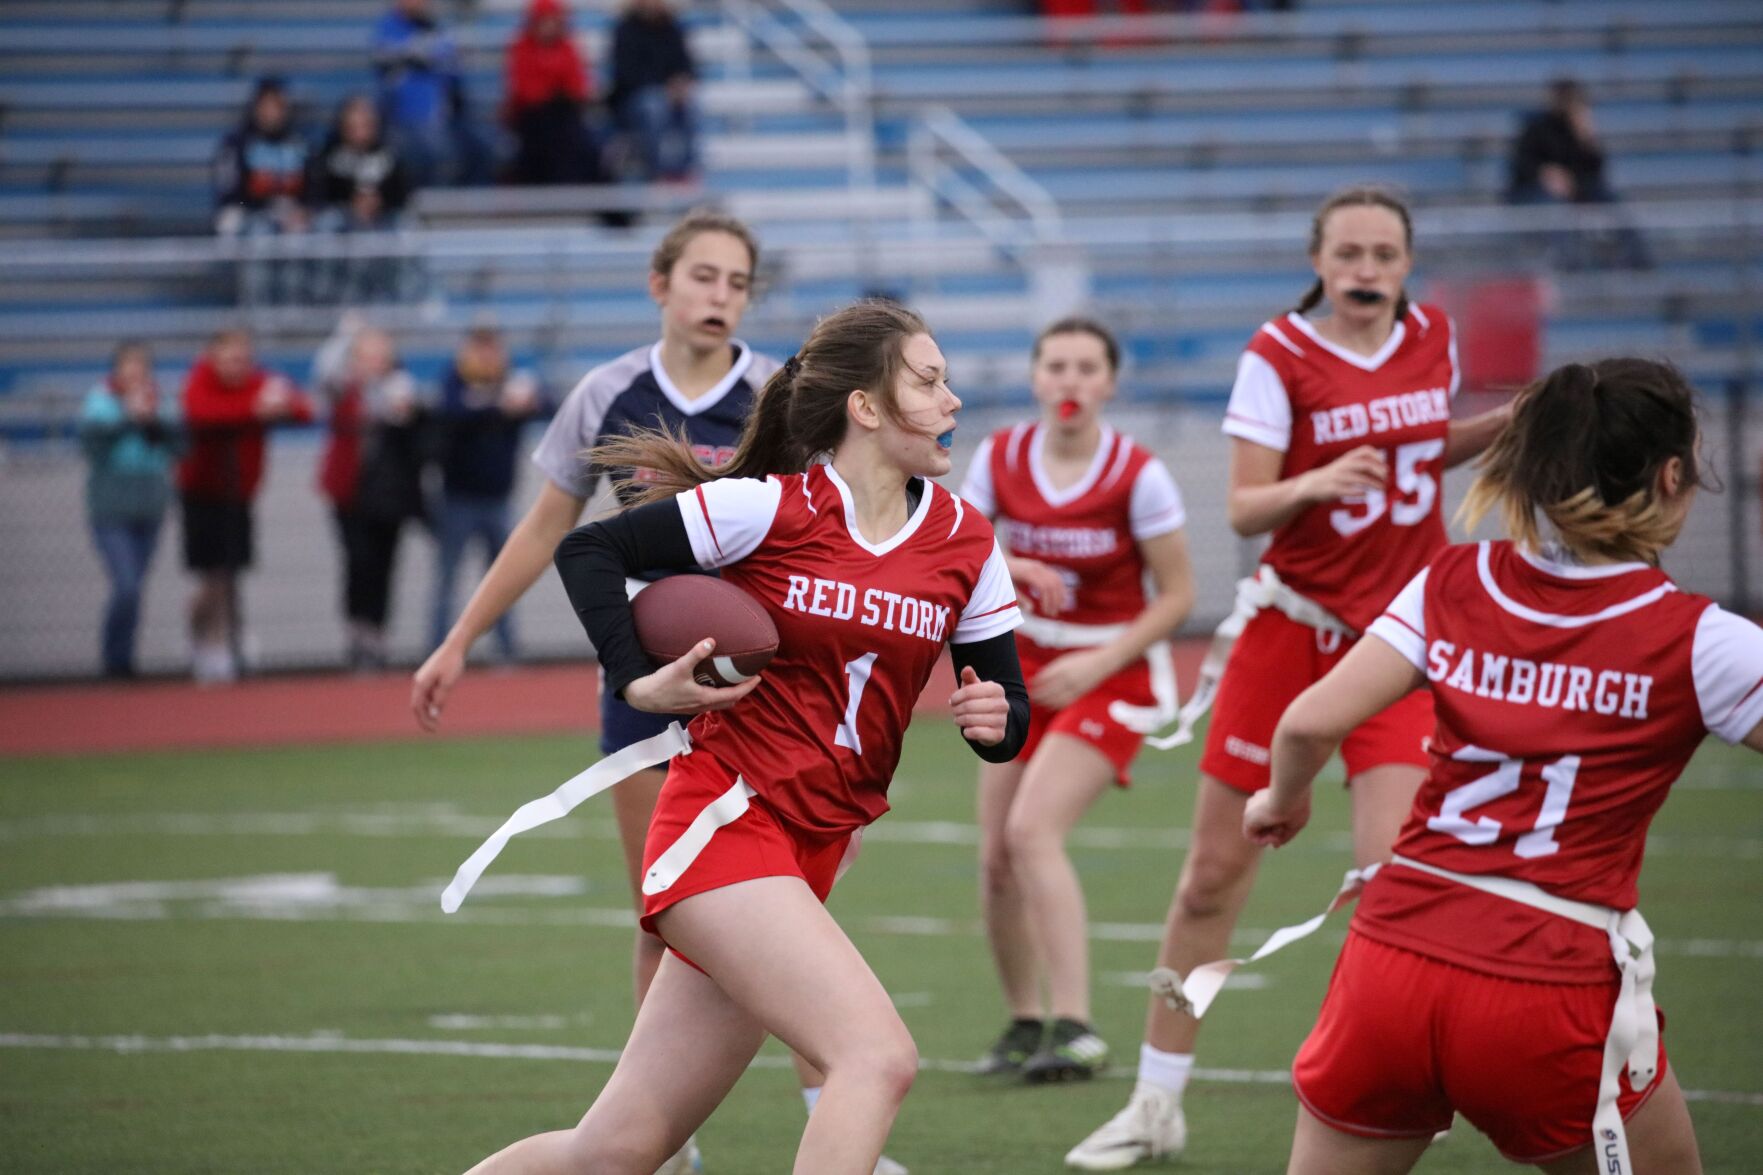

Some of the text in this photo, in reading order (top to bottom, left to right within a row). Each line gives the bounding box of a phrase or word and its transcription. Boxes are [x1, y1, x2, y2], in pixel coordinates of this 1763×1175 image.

[1311, 387, 1449, 444] RED STORM
[783, 575, 950, 642] RED STORM
[834, 652, 879, 756] 1
[1427, 640, 1653, 719] SAMBURGH
[1426, 744, 1581, 859] 21
